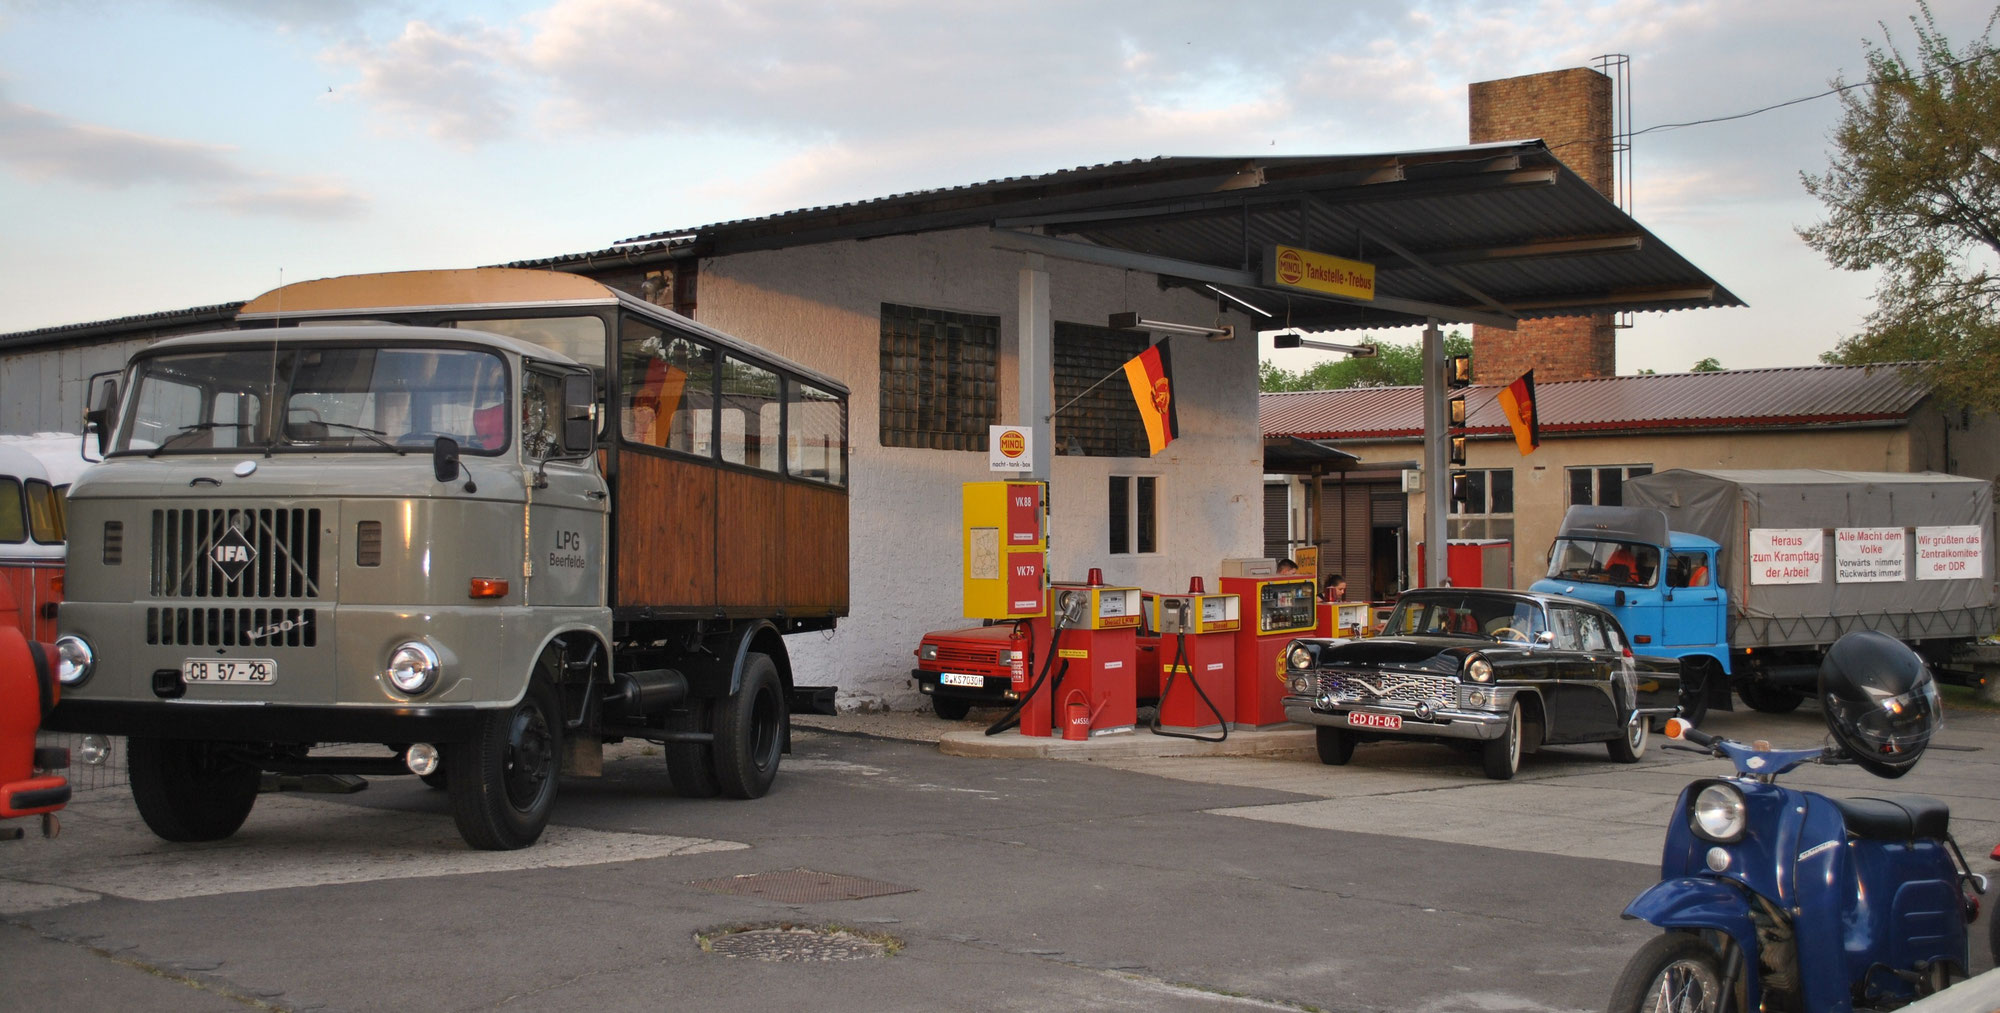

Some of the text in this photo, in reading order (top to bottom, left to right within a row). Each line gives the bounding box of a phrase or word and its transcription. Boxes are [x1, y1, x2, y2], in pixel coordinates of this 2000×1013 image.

[1280, 261, 1301, 274] MINOL
[1306, 263, 1344, 284] Tankstelle
[1348, 272, 1371, 290] Trebus
[1001, 440, 1023, 448] MINOL
[1016, 497, 1032, 507] VK88
[557, 530, 580, 551] LPG
[1771, 536, 1802, 546] Heraus
[1839, 531, 1901, 541] Alle Macht dem
[1918, 536, 1930, 544] Wir
[1966, 535, 1979, 544] das
[217, 546, 248, 562] IFA
[1860, 545, 1882, 554] Volke
[1921, 549, 1978, 558] Zentralkomitee
[550, 552, 584, 568] Beerfelde
[1753, 551, 1819, 563] zum Krampftag
[1839, 559, 1870, 567] Vorwärts
[1934, 561, 1965, 571] der DDR
[1017, 566, 1034, 576] VK79
[1766, 567, 1809, 577] der Arbeit
[191, 663, 208, 680] CB
[1353, 714, 1395, 727] CD 01-04
